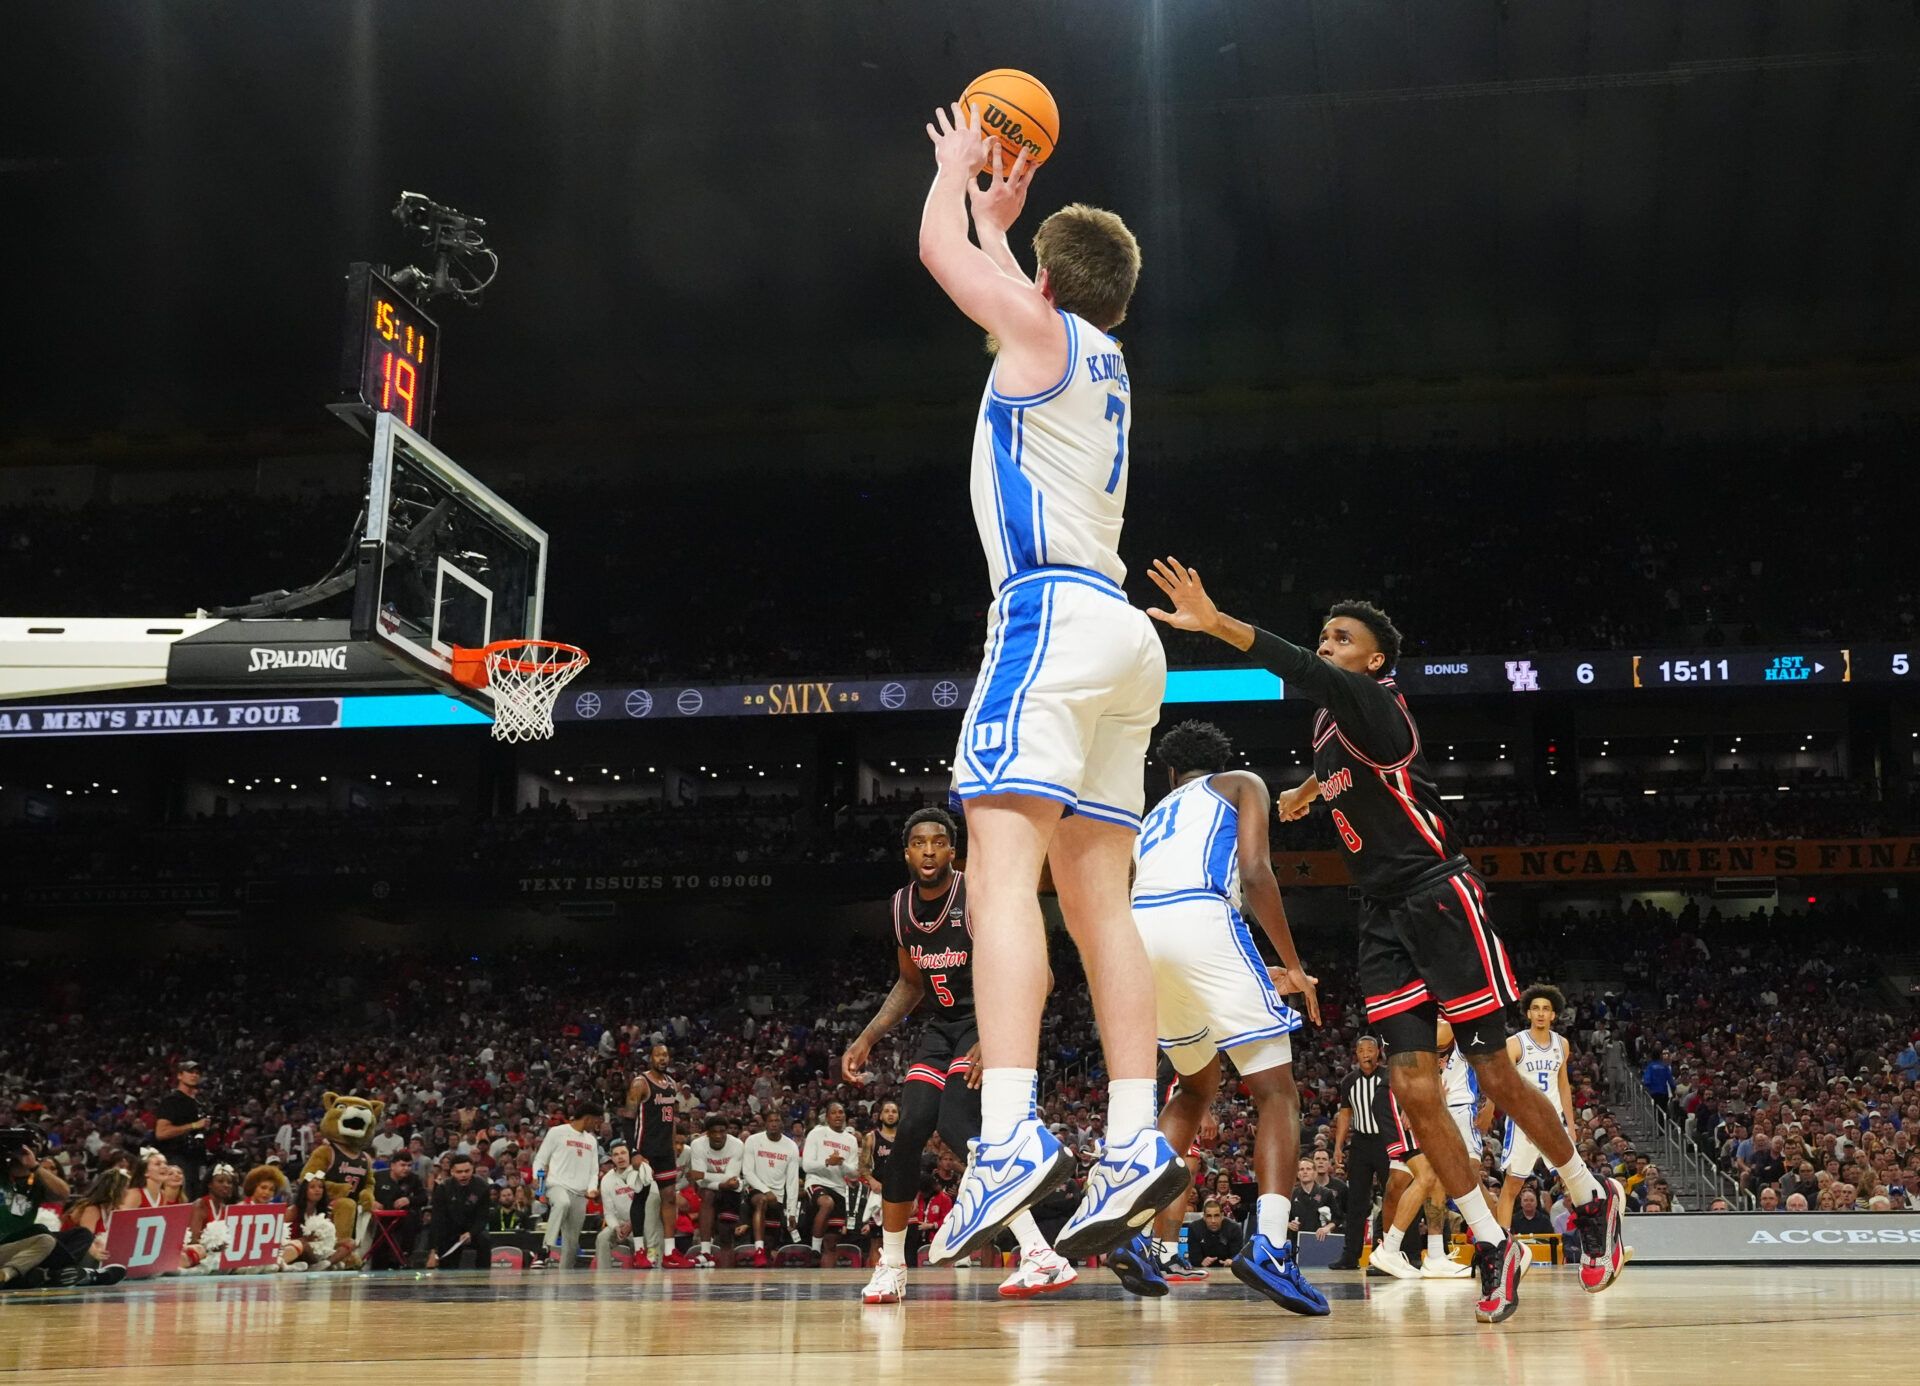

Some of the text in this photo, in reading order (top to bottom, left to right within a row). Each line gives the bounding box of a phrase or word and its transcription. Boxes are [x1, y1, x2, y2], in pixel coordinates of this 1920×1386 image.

[375, 300, 425, 364] 15:11
[383, 352, 416, 428] 19
[1104, 393, 1126, 494] 7
[248, 645, 348, 673] SPALDING
[1424, 663, 1469, 675] BONUS
[1658, 660, 1729, 682] 15:11
[1772, 656, 1804, 668] 1ST
[1892, 654, 1910, 675] 5
[1576, 663, 1595, 684] 6
[1764, 668, 1811, 681] HALF
[743, 683, 860, 715] 20 SATX 25
[41, 711, 126, 730] MEN'S
[134, 708, 219, 728] FINAL
[227, 705, 301, 725] FOUR
[1139, 796, 1183, 860] 21
[1331, 808, 1363, 853] 8
[1520, 848, 1638, 877] NCAA
[1658, 845, 1799, 872] MEN'S
[519, 874, 773, 891] TEXT ISSUES TO 69060
[910, 944, 968, 969] Houston
[930, 974, 955, 1007] 5
[1525, 1059, 1561, 1073] DUKE
[1538, 1072, 1549, 1092] 5
[127, 1215, 167, 1268] D
[226, 1213, 285, 1262] UP!
